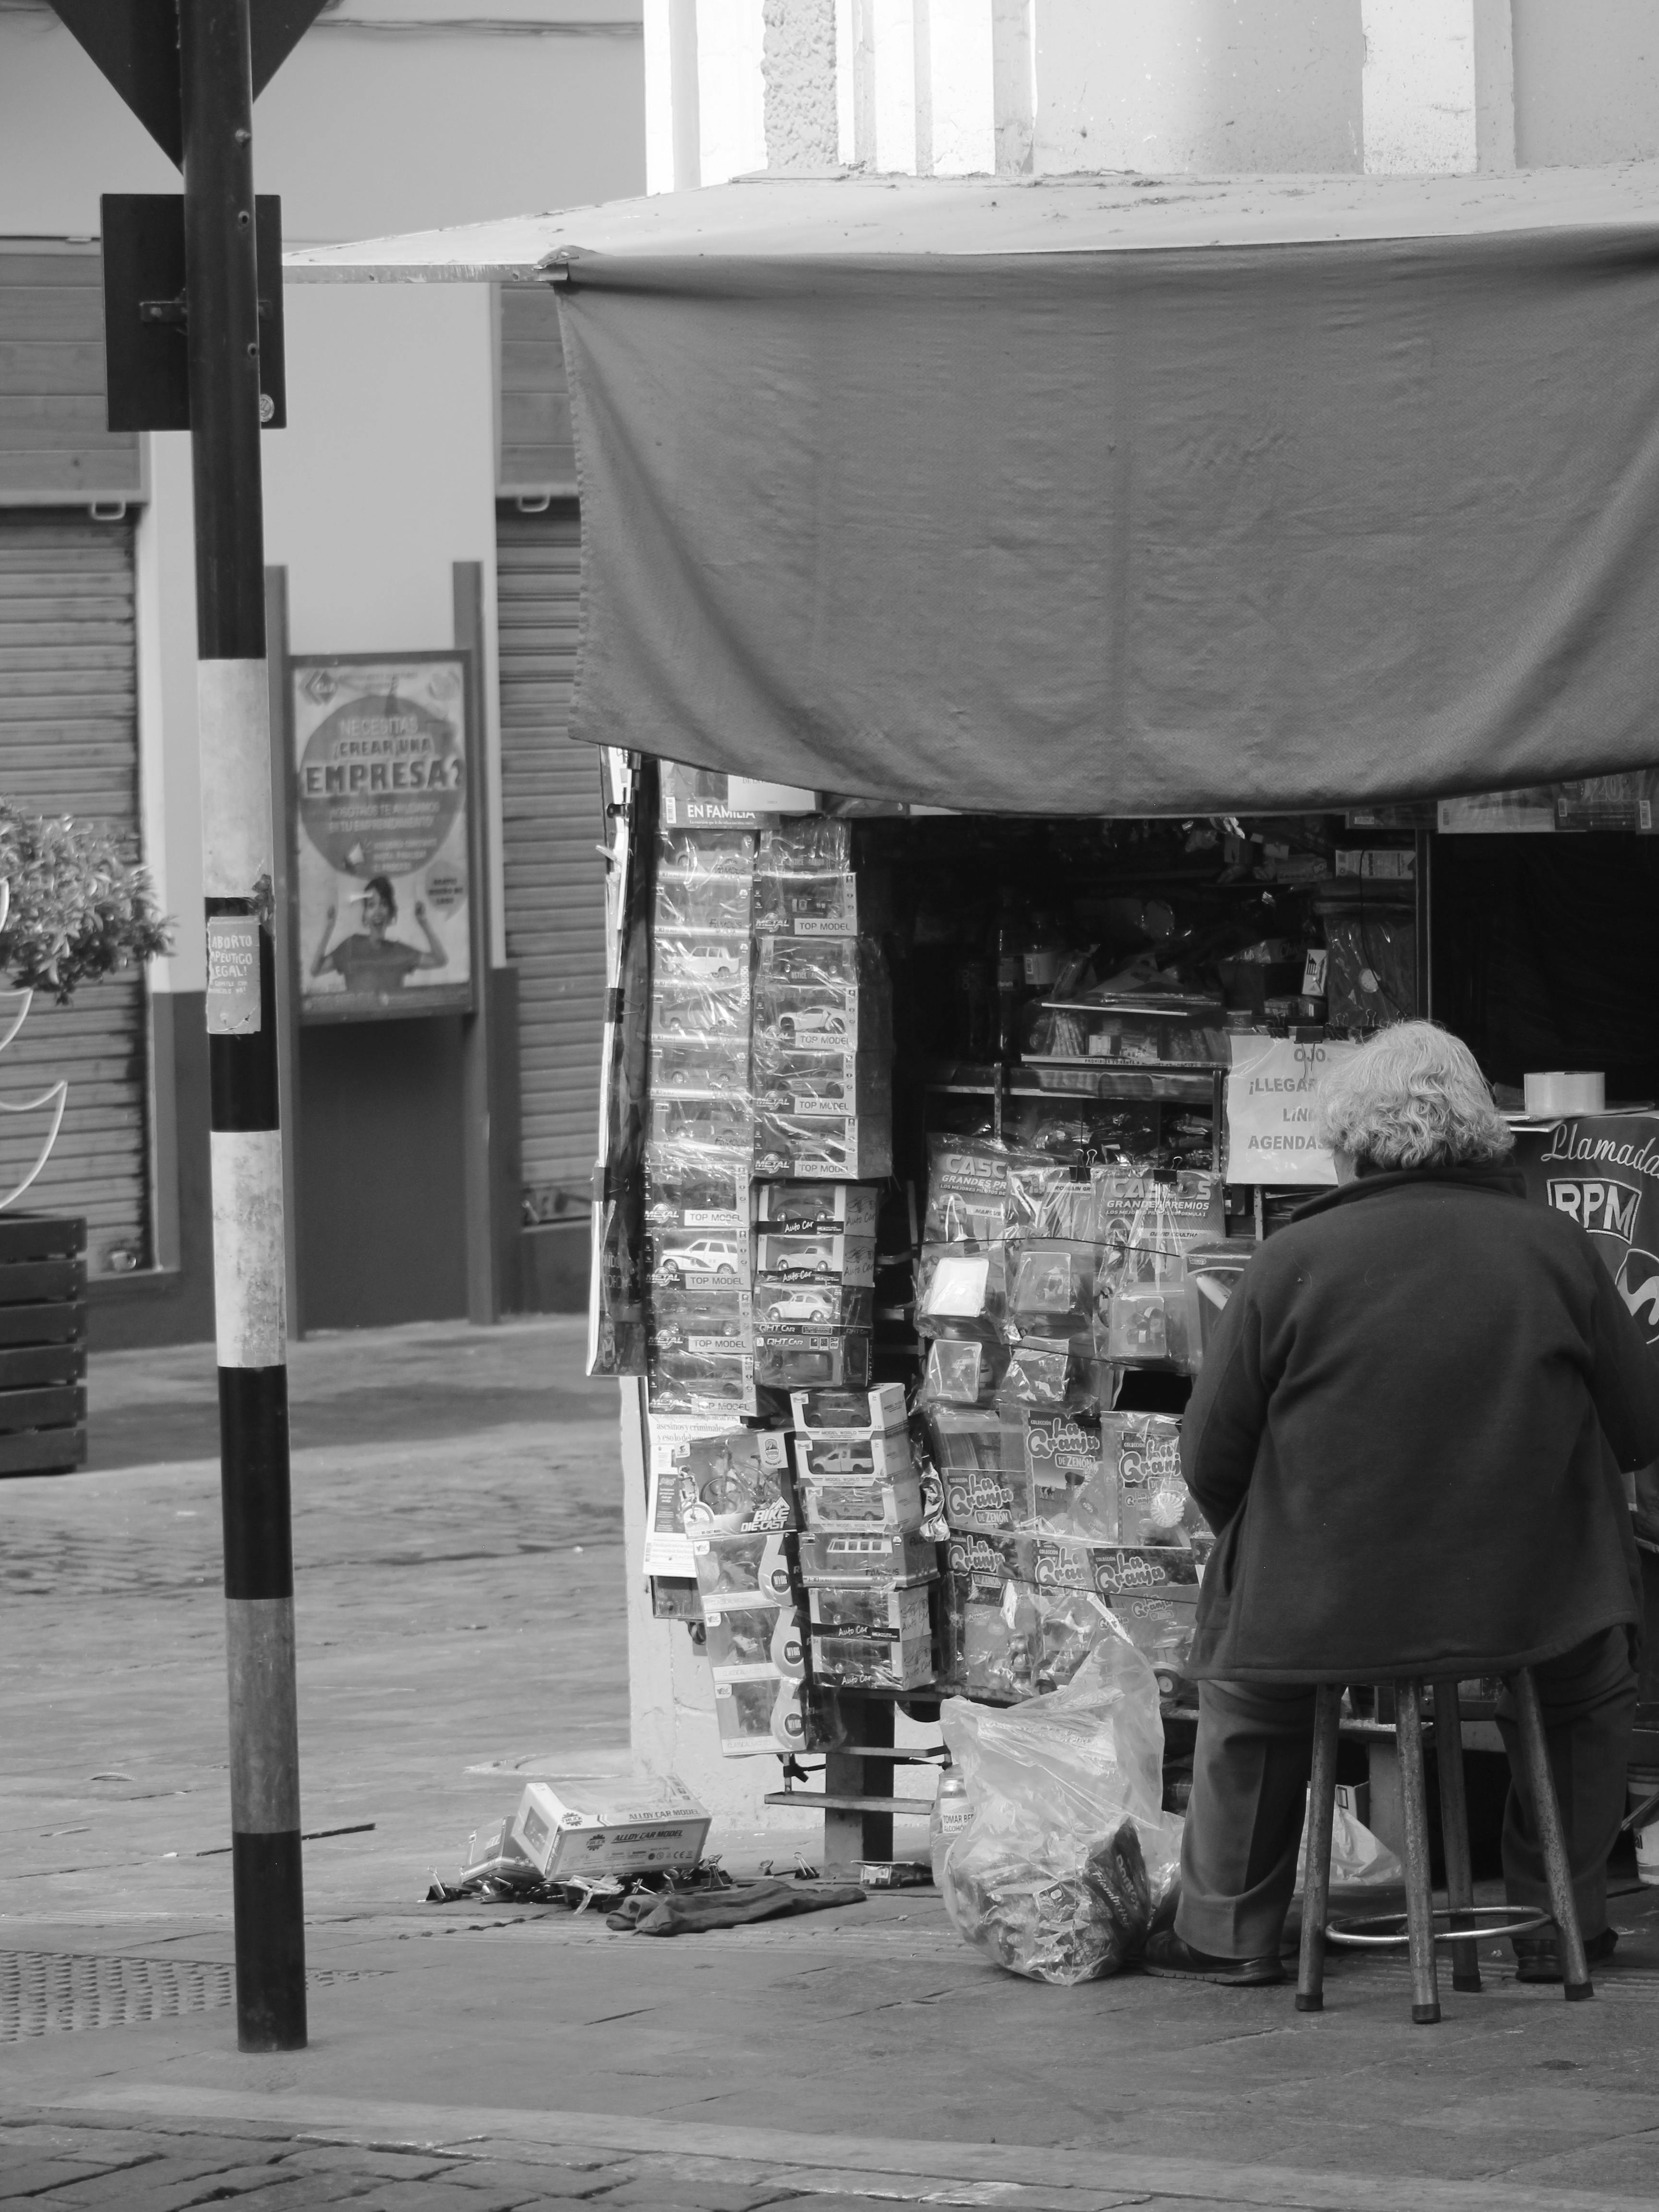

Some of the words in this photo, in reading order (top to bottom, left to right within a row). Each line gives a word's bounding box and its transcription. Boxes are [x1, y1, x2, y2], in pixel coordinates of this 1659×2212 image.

[305, 759, 462, 793] EMPRESA?
[687, 805, 704, 818] EN
[820, 923, 851, 931] MODEL
[212, 935, 253, 949] ABORTO
[800, 1035, 818, 1044] TOP
[821, 1036, 849, 1045] MODEL
[800, 1101, 817, 1109] TOP
[819, 1102, 849, 1110] MODEL
[1541, 1123, 1659, 1179] Llamada
[820, 1165, 848, 1173] MODEL
[945, 1154, 1007, 1179] CASC
[941, 1175, 992, 1189] GRANDES
[1106, 1200, 1163, 1209] GRANDES
[1164, 1201, 1210, 1210] PREMIOS
[1554, 1183, 1637, 1238] RPM
[711, 1214, 743, 1222] MODEL
[845, 1216, 862, 1226] Auto
[864, 1213, 876, 1221] Car
[784, 1223, 801, 1233] Auto
[802, 1220, 814, 1229] Car
[844, 1266, 861, 1276] Auto
[862, 1263, 874, 1272] Car
[782, 1273, 798, 1283] Auto
[800, 1270, 812, 1278] Car
[759, 1324, 781, 1334] QHT
[715, 1340, 747, 1348] MODEL
[718, 1403, 750, 1411] MODEL
[1053, 1418, 1079, 1439] La
[1026, 1428, 1100, 1459] Granja
[1146, 1440, 1174, 1461] La
[1058, 1456, 1066, 1466] DE
[1119, 1451, 1181, 1483] Granj
[969, 1474, 994, 1495] La
[949, 1485, 1014, 1516] Granja
[753, 1507, 790, 1522] BIKE
[986, 1510, 1008, 1523] ZENÓN
[741, 1519, 788, 1532] DIE-CAST
[967, 1535, 989, 1558] La
[1117, 1552, 1144, 1574] La
[1035, 1557, 1086, 1589] Gran
[1095, 1564, 1166, 1594] Granja
[838, 1626, 855, 1636] Auto
[841, 1675, 859, 1685] Auto
[655, 1810, 672, 1818] CAR
[673, 1809, 700, 1817] MODEL
[943, 1815, 962, 1824] TOMAR
[613, 1833, 639, 1841] ALLOY
[639, 1831, 656, 1839] CAR
[657, 1829, 683, 1838] MODEL
